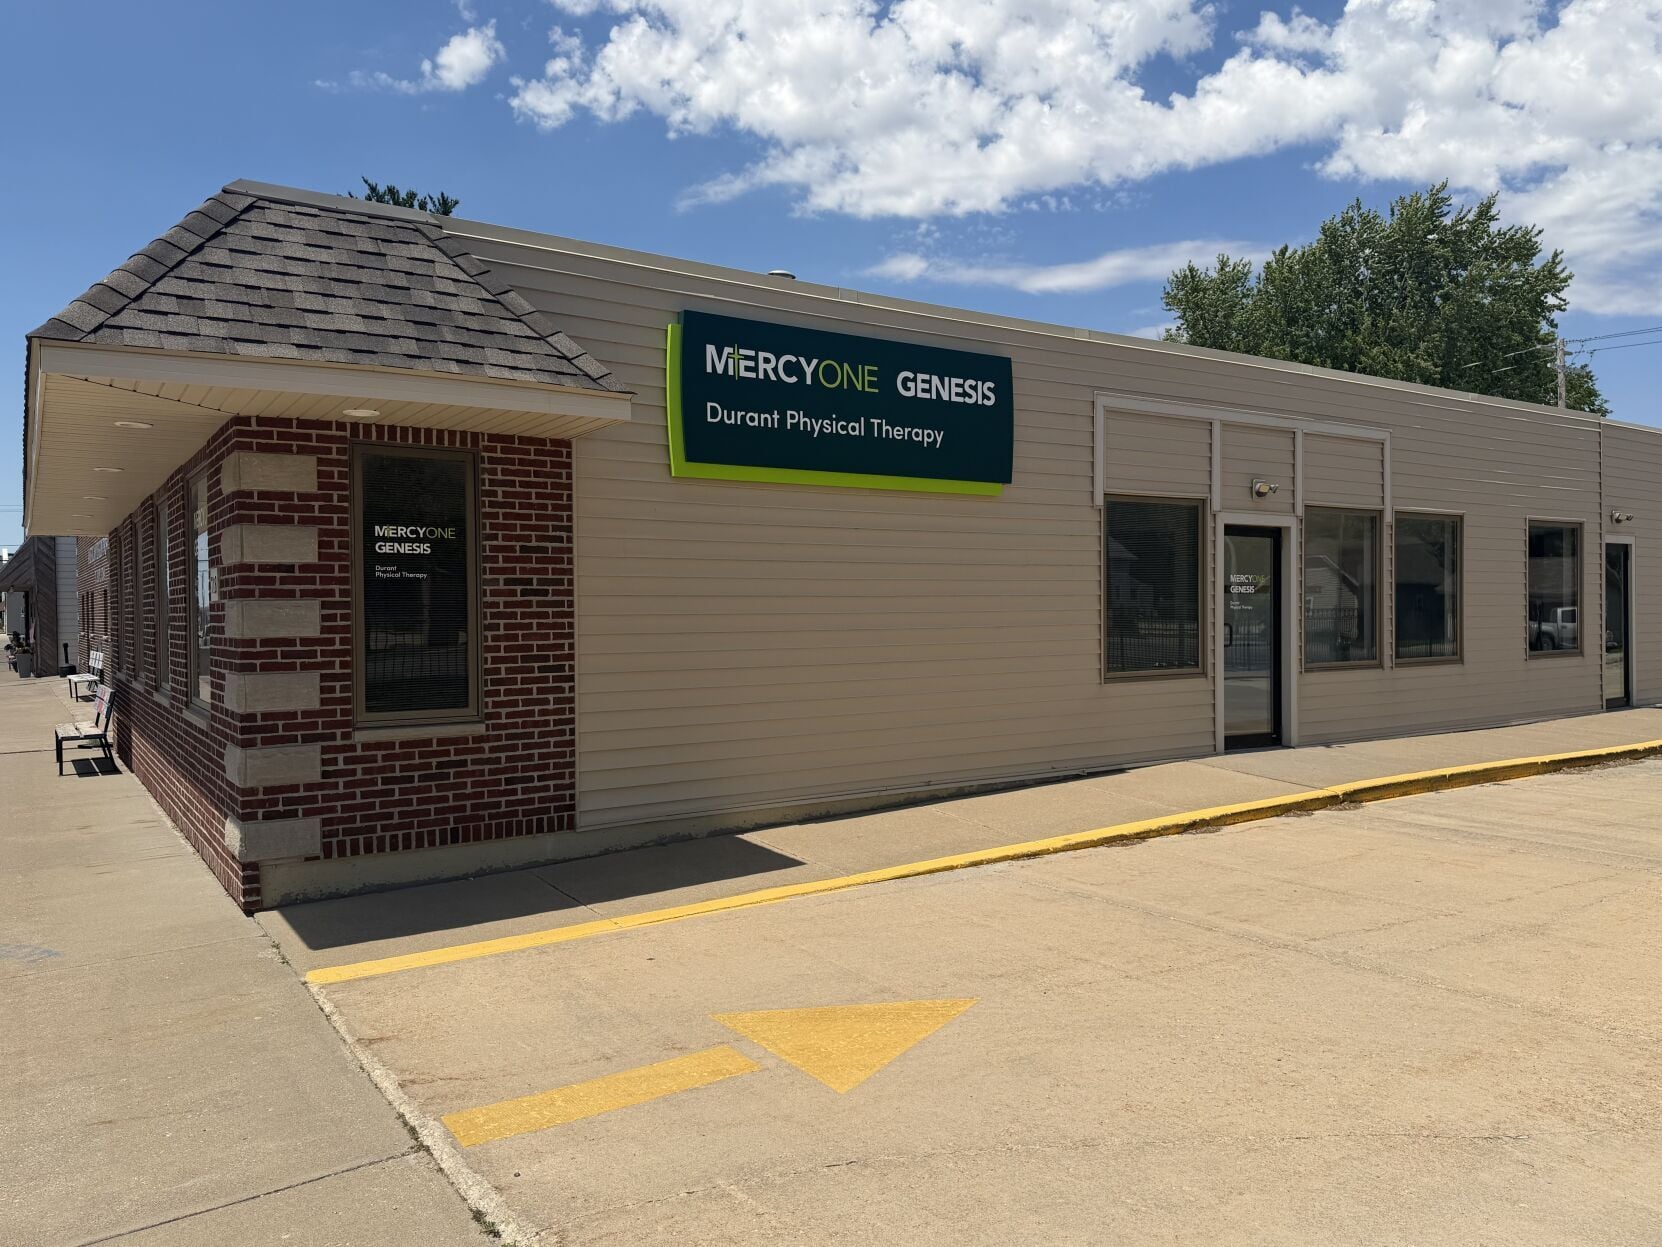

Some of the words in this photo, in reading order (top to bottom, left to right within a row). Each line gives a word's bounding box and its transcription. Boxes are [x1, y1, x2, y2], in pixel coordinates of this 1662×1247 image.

[705, 343, 879, 393] MERCYONE
[897, 371, 996, 406] GENESIS
[706, 402, 780, 428] Durant
[787, 411, 865, 437] Physical
[870, 419, 944, 448] Therapy
[374, 525, 456, 539] MERCYONE
[375, 542, 431, 554] GENESIS
[1230, 585, 1255, 593] GENESIS
